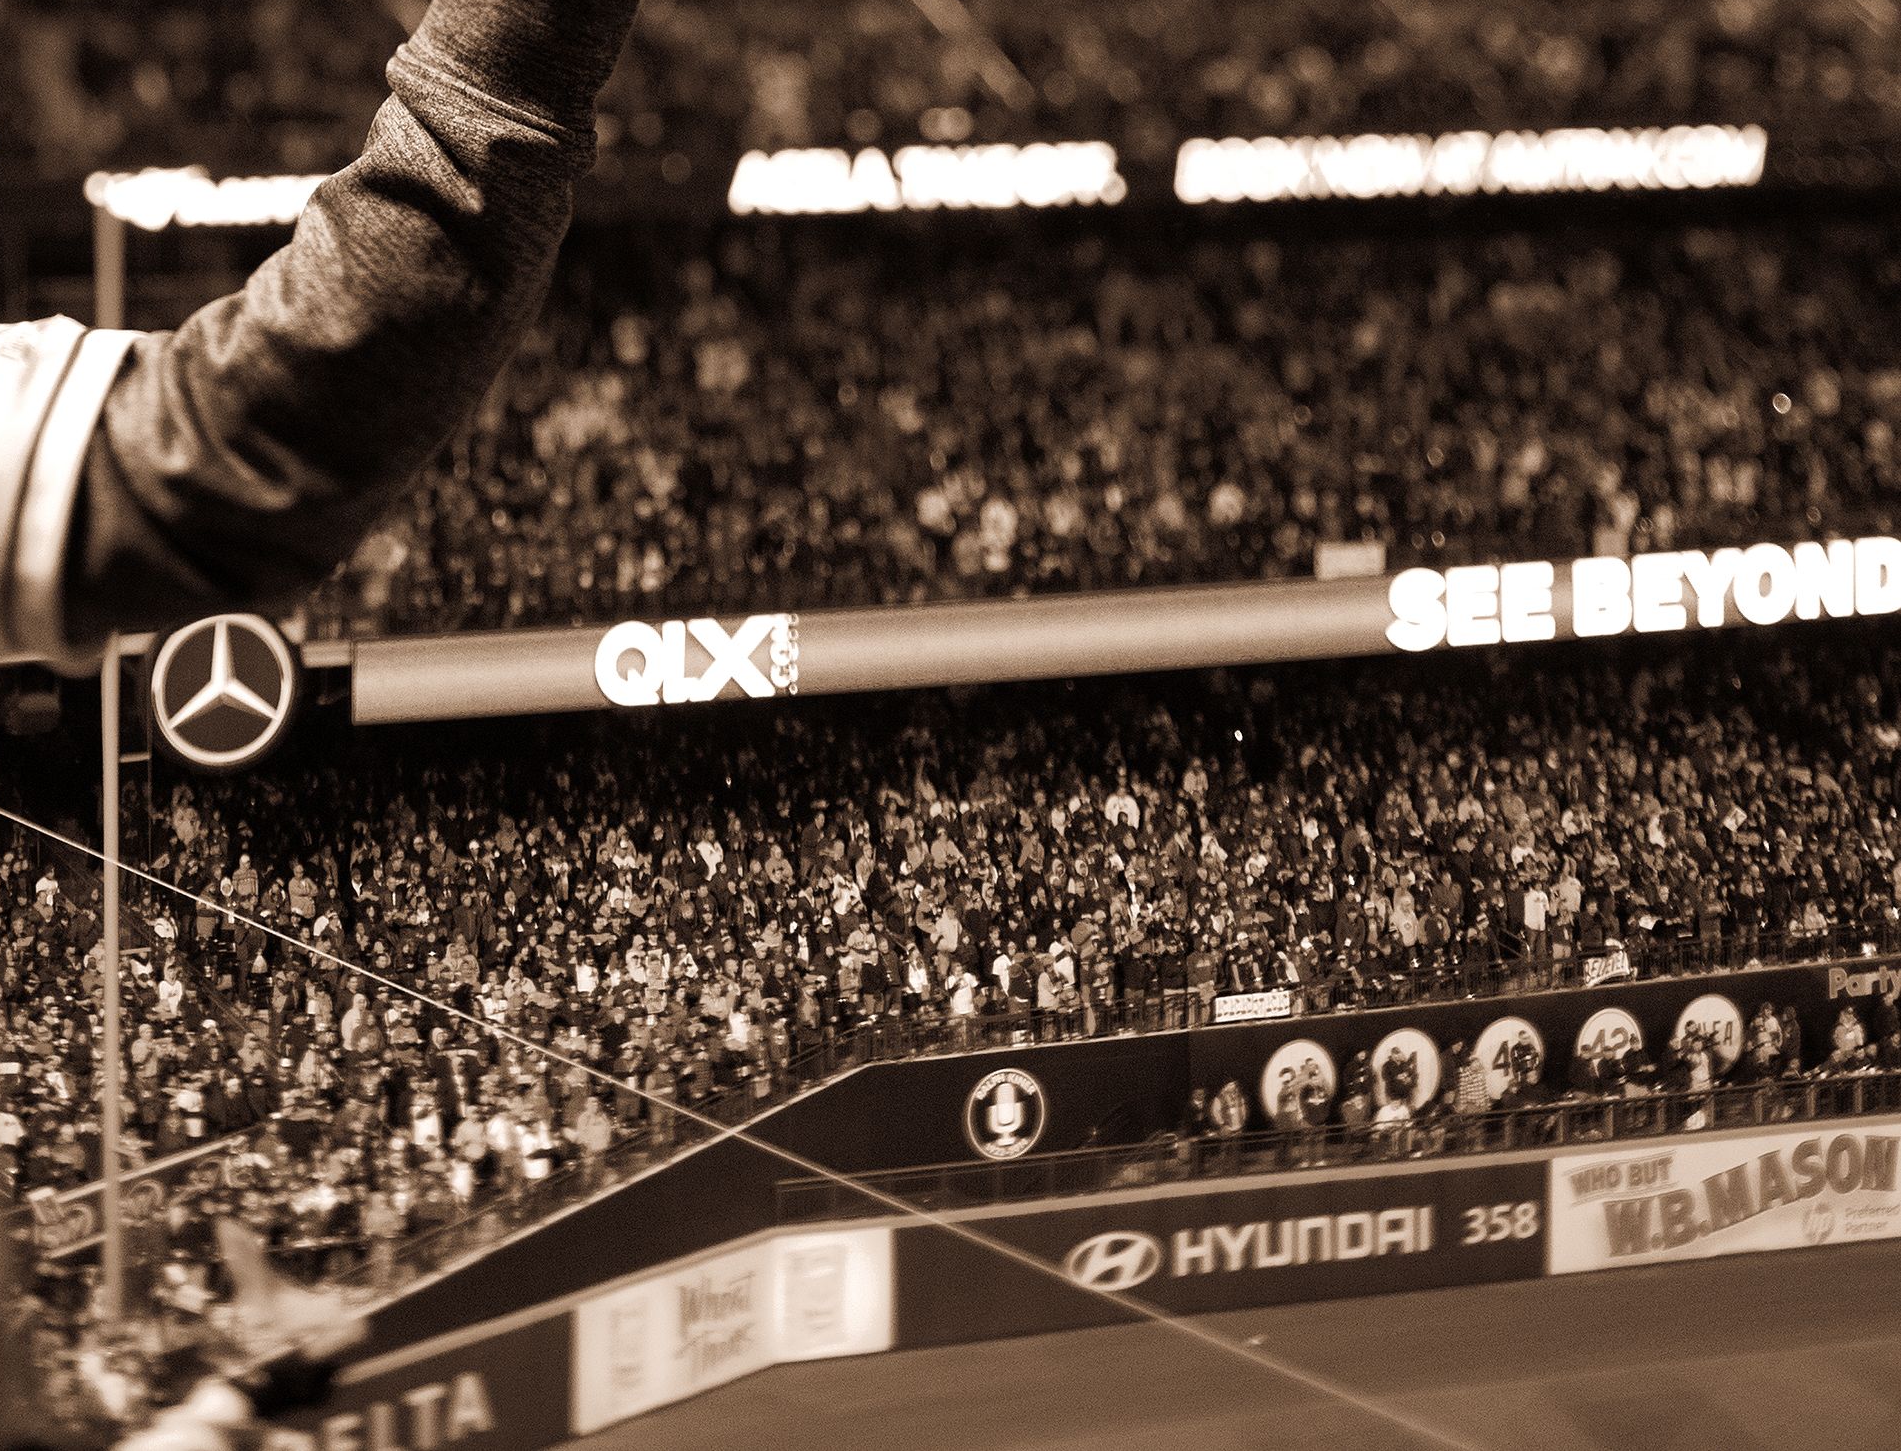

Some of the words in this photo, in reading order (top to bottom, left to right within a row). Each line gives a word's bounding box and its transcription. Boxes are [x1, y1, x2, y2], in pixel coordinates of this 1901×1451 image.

[1386, 561, 1556, 652] SEE
[1572, 536, 1901, 638] BEYOND
[1570, 1164, 1623, 1197] WHO
[1628, 1155, 1674, 1189] BUT
[1173, 1206, 1435, 1278] HYUNDAI
[1462, 1201, 1540, 1247] 358
